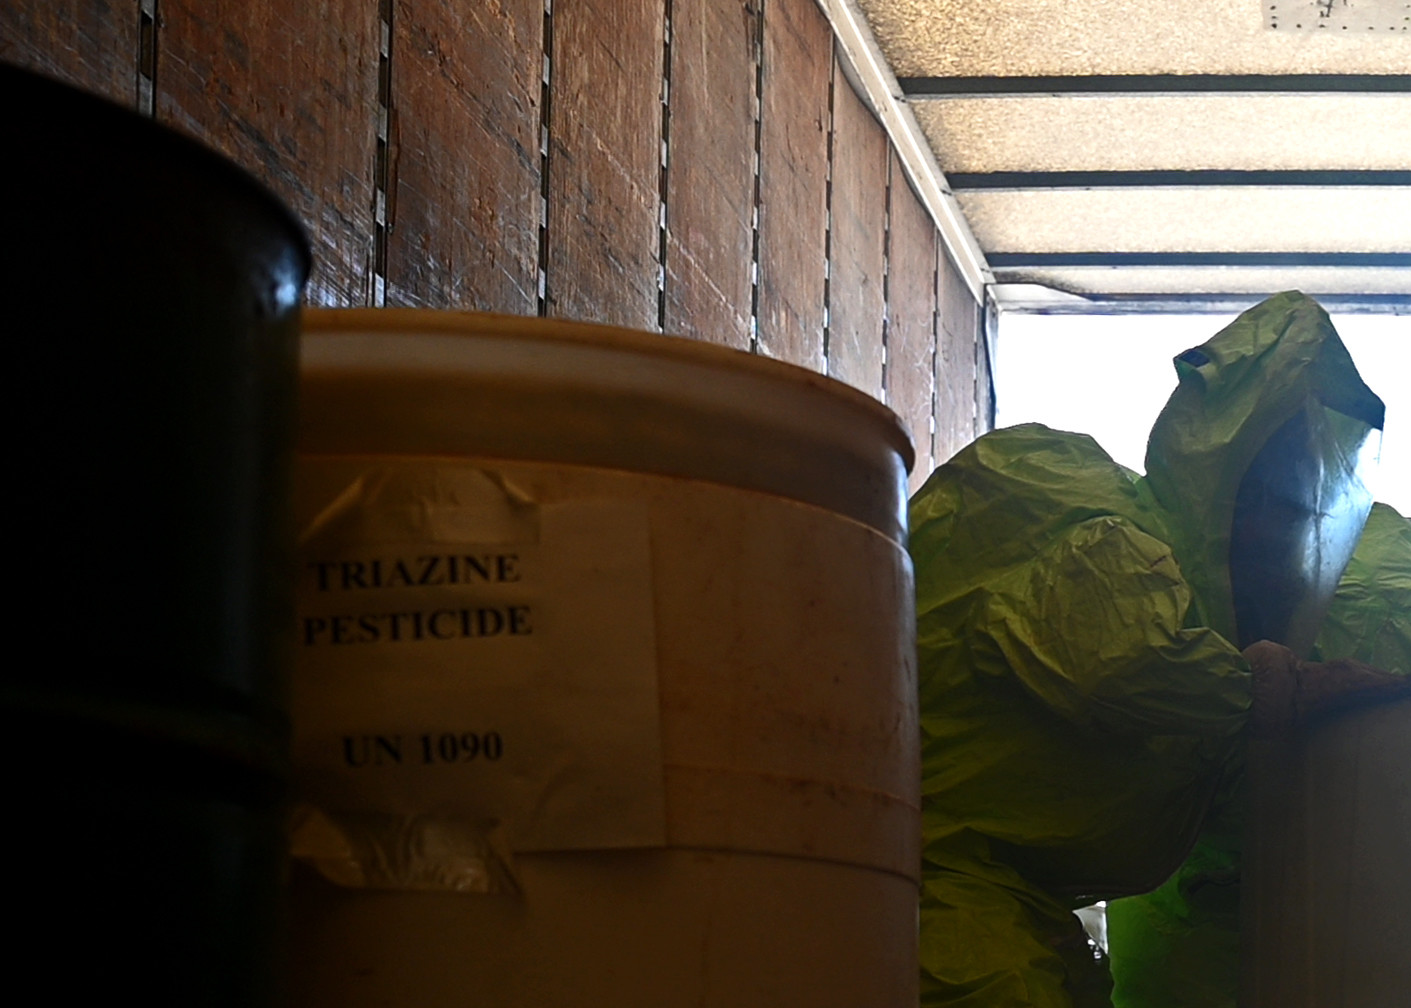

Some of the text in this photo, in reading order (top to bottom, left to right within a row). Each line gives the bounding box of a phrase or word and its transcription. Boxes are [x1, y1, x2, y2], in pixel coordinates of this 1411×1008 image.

[308, 555, 521, 591] TRIAZINE
[303, 606, 533, 646] PESTICIDE
[343, 732, 503, 768] UN 1090
